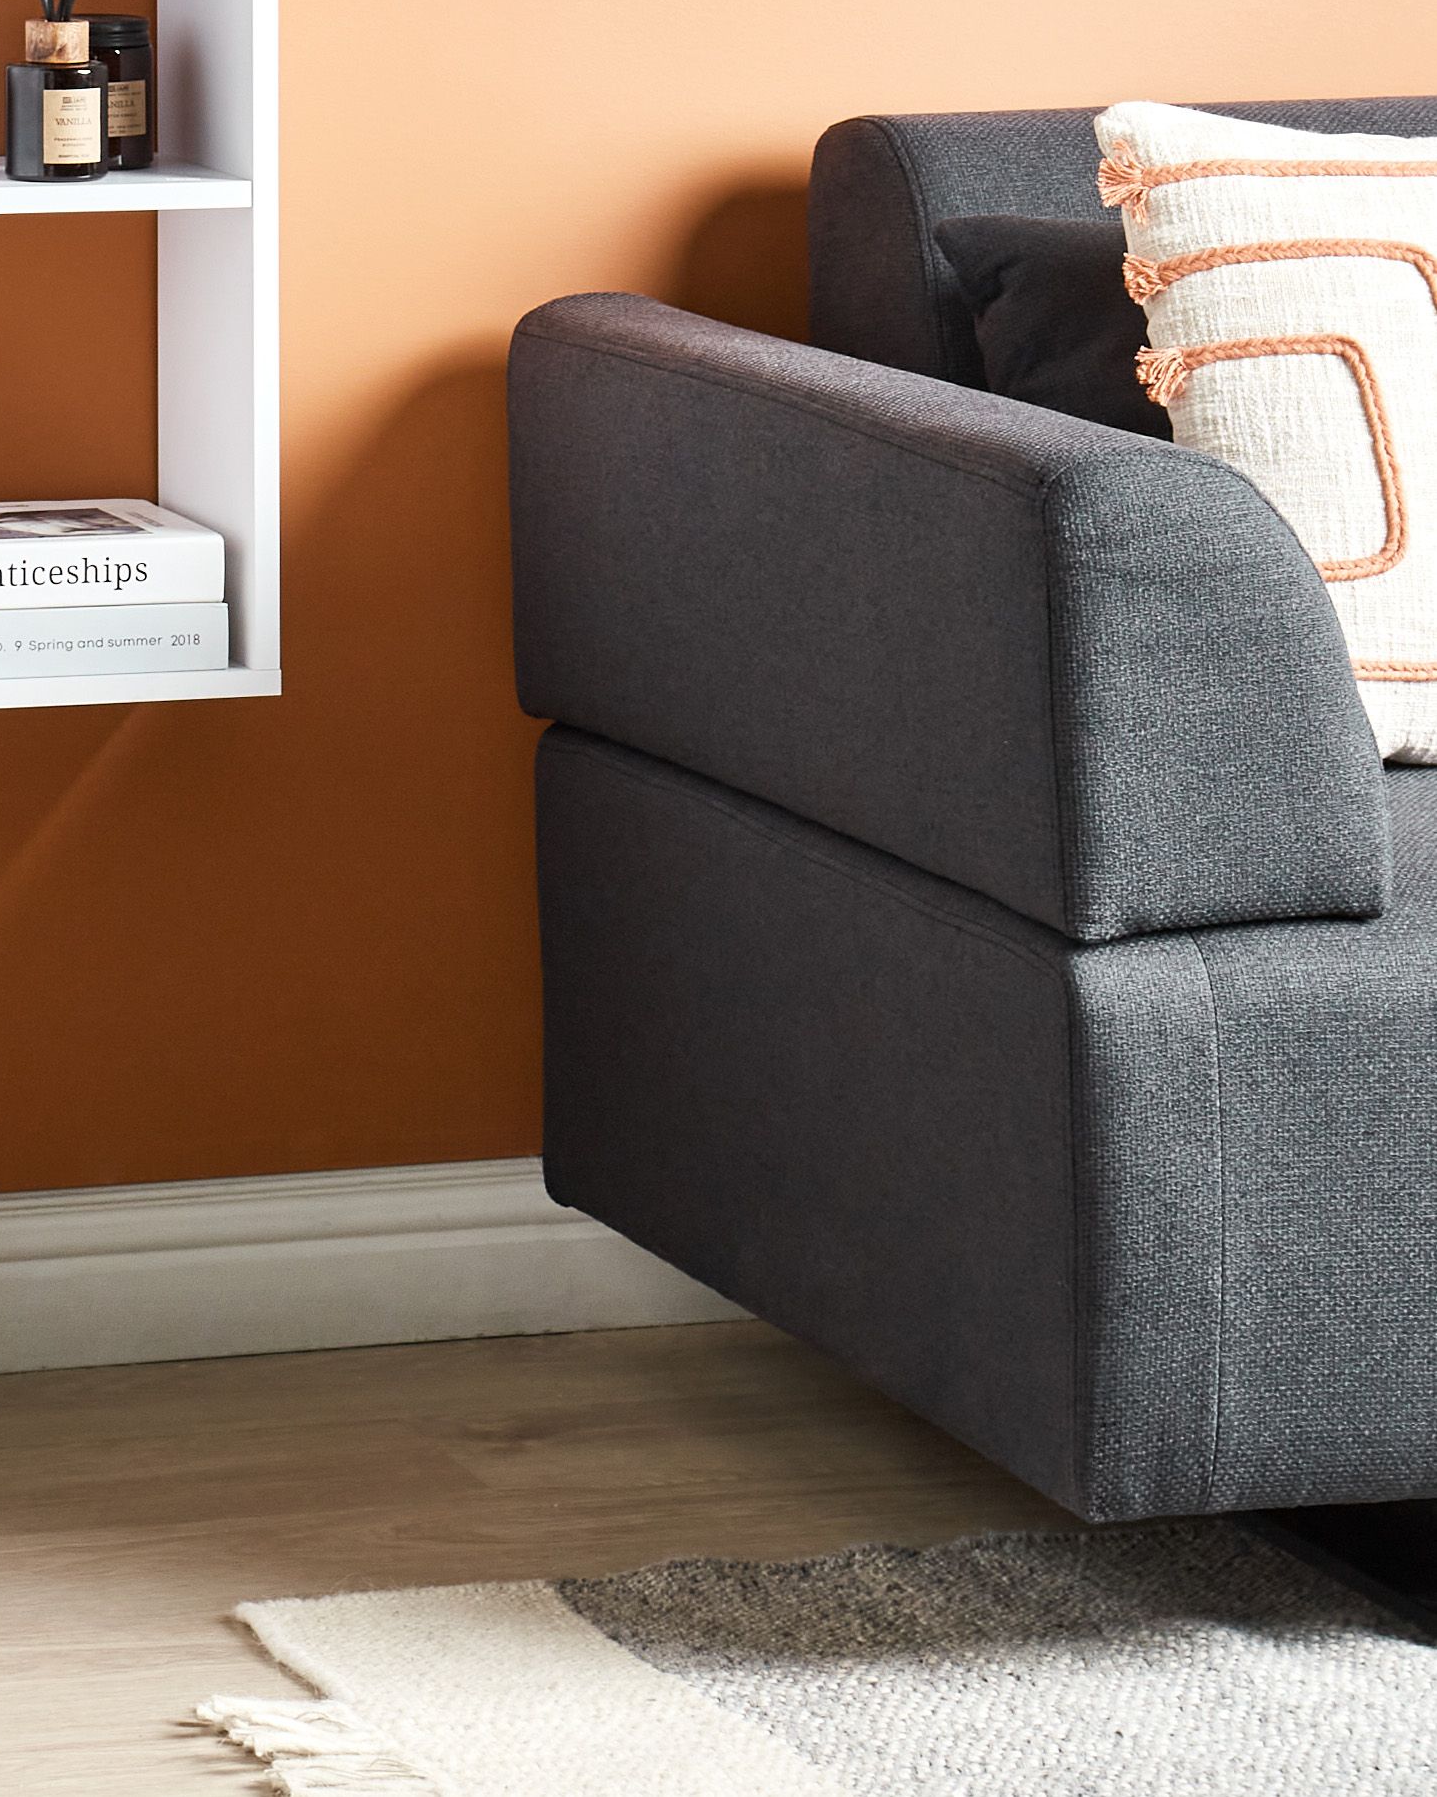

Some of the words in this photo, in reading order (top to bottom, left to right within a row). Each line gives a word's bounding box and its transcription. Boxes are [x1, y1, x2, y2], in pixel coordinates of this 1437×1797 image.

[55, 117, 92, 127] VANILLA
[14, 640, 23, 652] 9
[28, 638, 74, 652] Spring
[77, 636, 104, 649] and
[107, 636, 163, 648] summer
[170, 634, 201, 647] 2018
